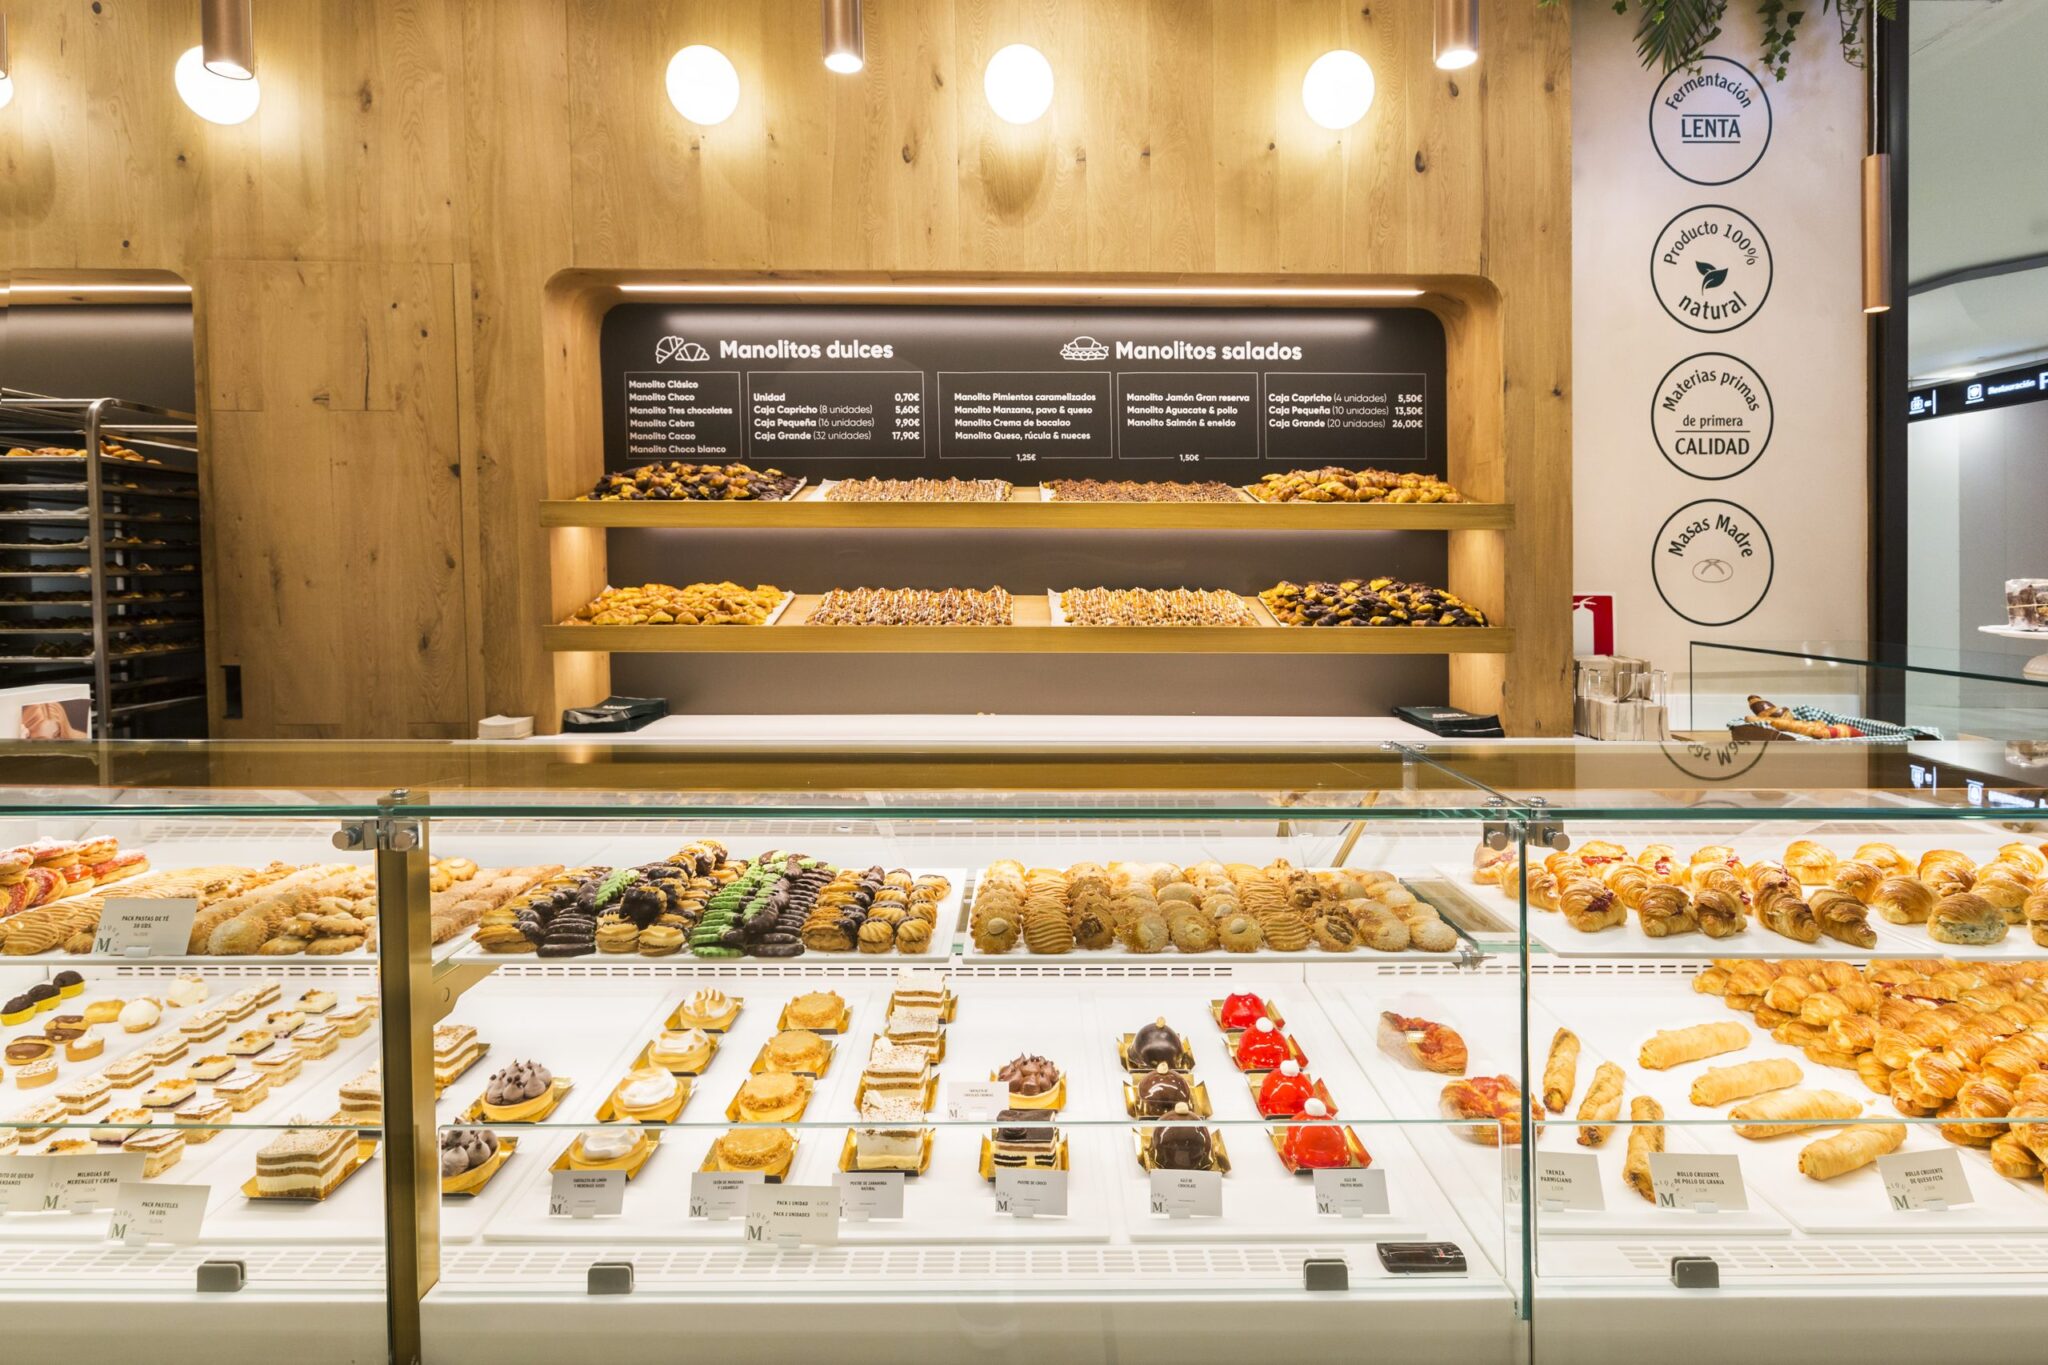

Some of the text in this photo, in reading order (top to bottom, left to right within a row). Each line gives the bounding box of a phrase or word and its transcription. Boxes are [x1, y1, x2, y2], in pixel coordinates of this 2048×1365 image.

[1665, 72, 1752, 110] Fermentación
[1681, 118, 1741, 138] LENTA
[1663, 220, 1759, 266] Producto 100%
[1678, 290, 1747, 320] natural
[720, 339, 893, 359] Manolitos dulces
[1115, 340, 1302, 360] Manolitos salados
[629, 380, 698, 389] Manolito Clásico
[1662, 369, 1760, 412] Materias primas
[629, 393, 695, 401] Manolito Choco
[753, 393, 786, 401] Unidad
[894, 393, 920, 403] 0,70€
[954, 393, 1096, 401] Manolito Pimientos caramelizados
[1127, 393, 1164, 402] Manolito
[1165, 393, 1194, 402] Jamón
[1196, 394, 1217, 402] Gran
[1268, 393, 1387, 403] Caja Capricho (4 unidades)
[1398, 394, 1423, 403] 5,50€
[630, 406, 733, 415] Manolito Tres chocolates
[754, 405, 873, 415] Caja Capricho (8 unidades)
[895, 406, 920, 415] 5,60€
[954, 406, 991, 414] Manolito
[992, 406, 1035, 415] Manzana,
[1059, 406, 1066, 414] &
[1067, 408, 1093, 416] queso
[1127, 406, 1238, 416] Manolito Aguacate & pollo
[1268, 406, 1389, 416] Caja Pequeña (10 unidades)
[1395, 407, 1423, 416] 13,50€
[630, 419, 695, 428] Manolito Cebra
[754, 418, 875, 428] Caja Pequeña (16 unidades)
[895, 418, 920, 428] 9,90€
[955, 419, 1071, 427] Manolito Crema de bacalao
[1127, 419, 1236, 427] Manolito Salmón & eneldo
[1269, 418, 1386, 429] Caja Grande (20 unidades)
[1392, 420, 1423, 429] 26,00€
[1682, 414, 1744, 429] de primera
[630, 432, 696, 440] Manolito Cacao
[754, 431, 872, 442] Caja Grande (32 unidades)
[892, 432, 920, 441] 17,90€
[955, 432, 992, 440] Manolito
[994, 432, 1023, 441] Queso,
[1024, 431, 1051, 440] rúcula
[1053, 432, 1060, 440] &
[630, 445, 727, 454] Manolito Choco blanco
[1675, 437, 1750, 455] CALIDAD
[1016, 454, 1036, 462] 1,25€
[1179, 454, 1200, 463] 1,50€
[1668, 513, 1753, 558] Masas Madre
[1660, 1193, 1676, 1208] M
[111, 1224, 128, 1239] M
[748, 1226, 763, 1241] M
